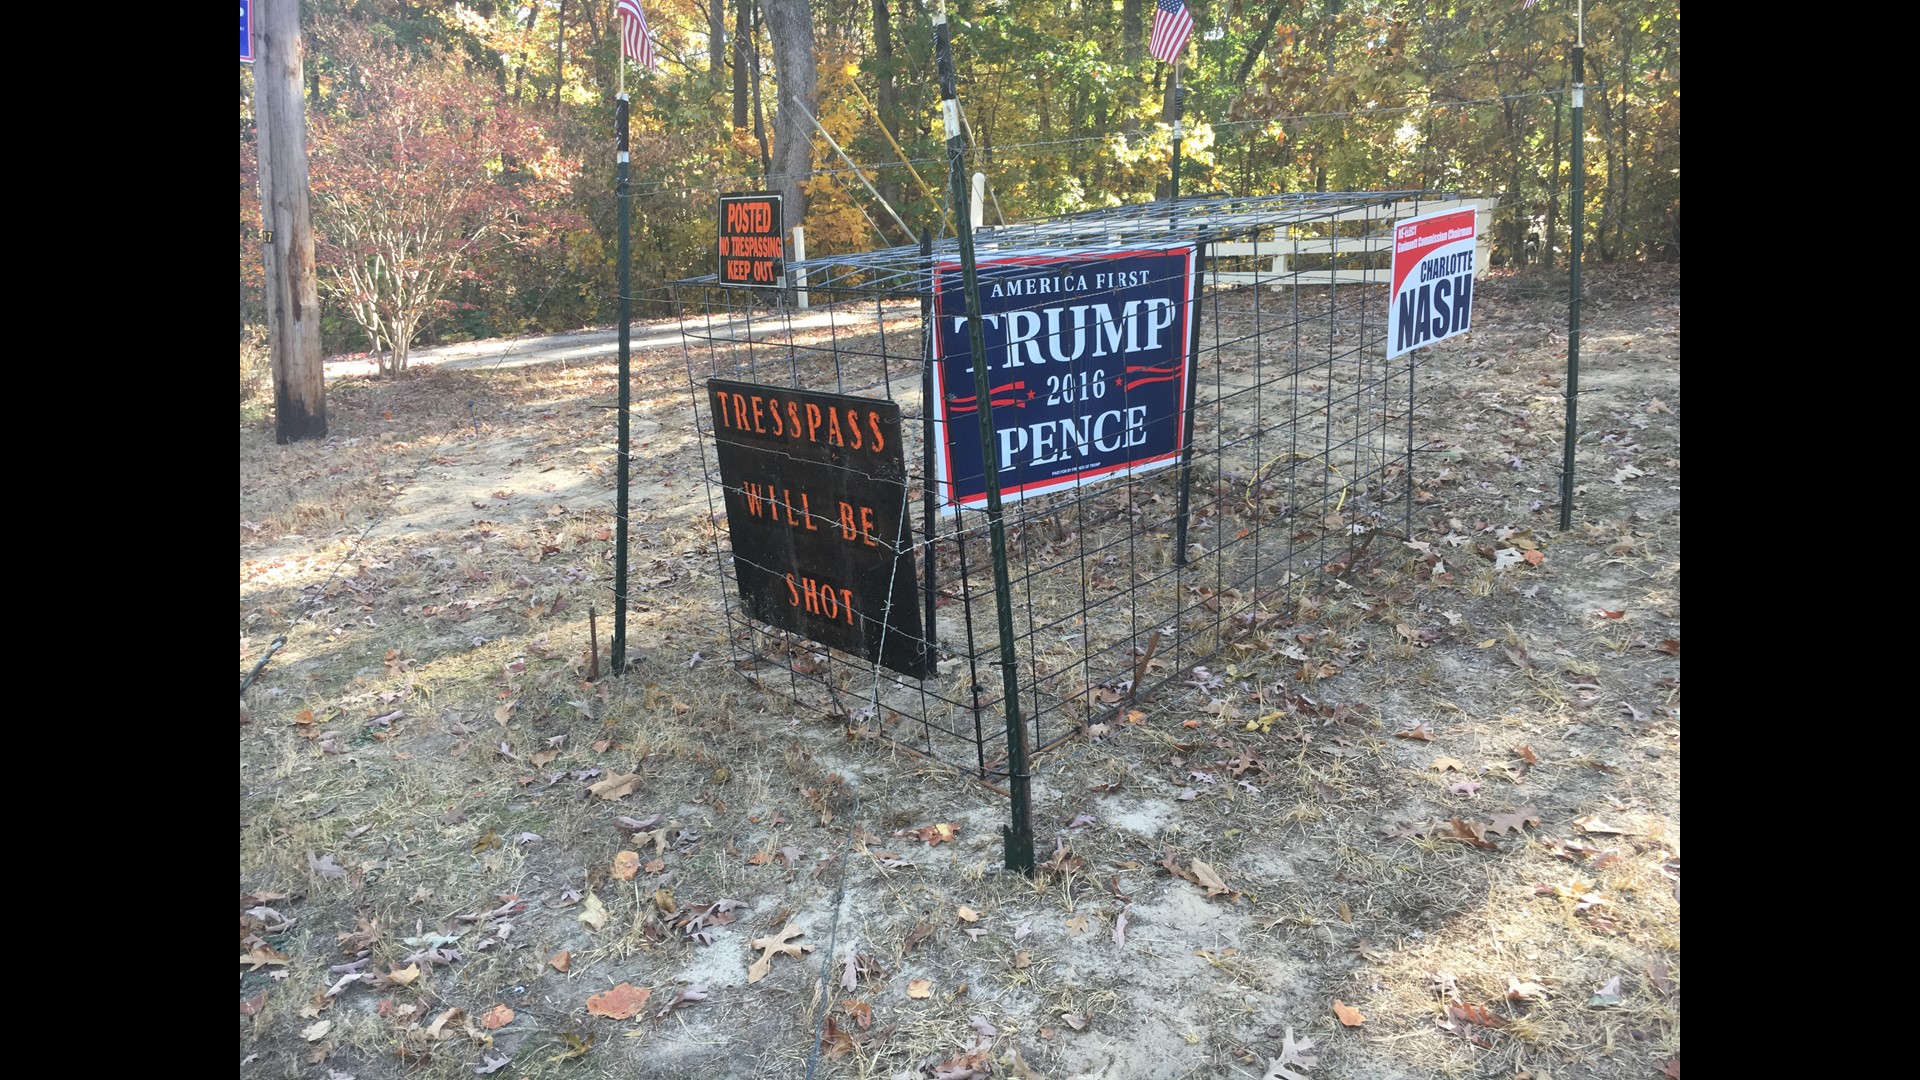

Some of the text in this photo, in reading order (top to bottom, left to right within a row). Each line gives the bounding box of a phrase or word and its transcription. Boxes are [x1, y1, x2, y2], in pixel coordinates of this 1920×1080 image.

[727, 202, 771, 233] POSTED
[720, 236, 782, 258] NO TRESPASSING
[1418, 232, 1448, 248] Commission
[1448, 226, 1473, 240] Chairman
[727, 260, 774, 282] KEEP OUT
[991, 270, 1151, 298] AMERICA FIRST
[1420, 250, 1473, 283] CHARLOTTE
[1397, 273, 1473, 352] NASH
[954, 298, 1176, 373] TRUMP
[1046, 369, 1106, 406] 2016
[717, 391, 885, 452] TRESSPASS
[997, 405, 1147, 473] PENCE
[743, 481, 879, 547] WILL BE
[785, 572, 853, 625] SHOT
